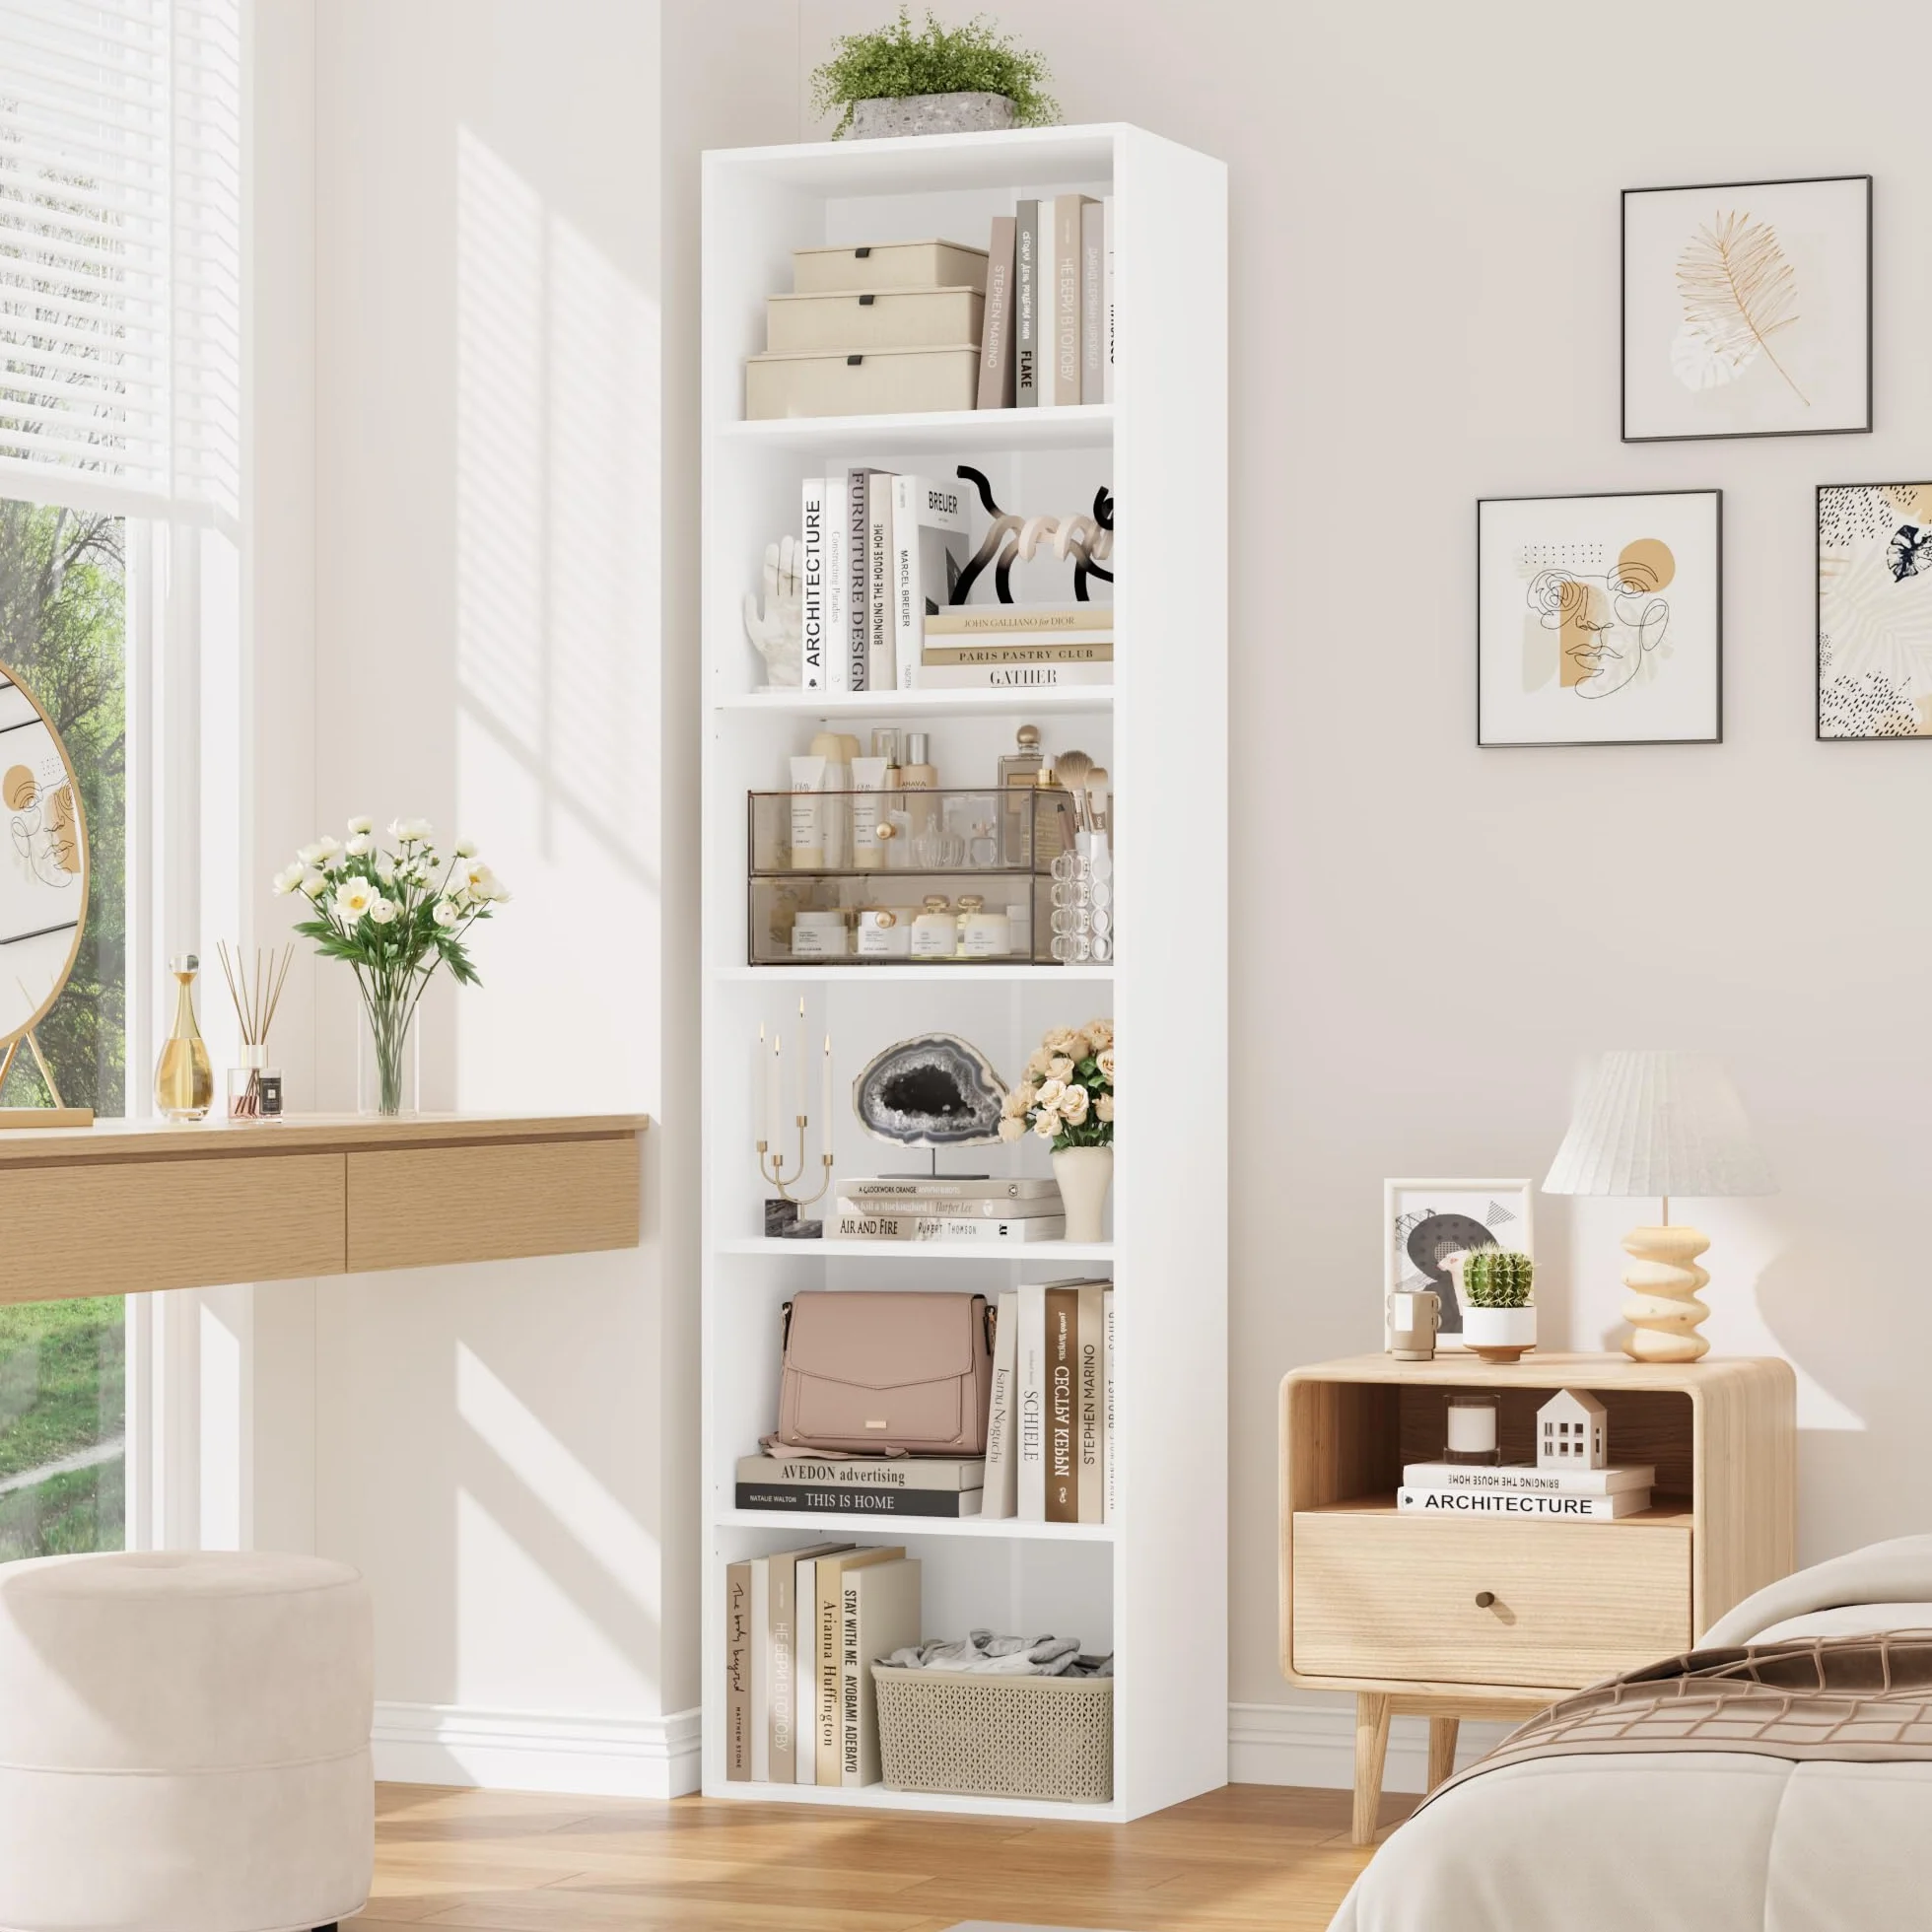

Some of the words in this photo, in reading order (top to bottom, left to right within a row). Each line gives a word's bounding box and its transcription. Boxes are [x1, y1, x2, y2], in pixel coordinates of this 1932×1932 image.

[1060, 257, 1074, 275] НЕ
[991, 265, 1005, 318] STEPHEN
[1060, 278, 1074, 312] БЕРИ
[1060, 316, 1074, 326] В
[988, 321, 1000, 369] MARINO
[1060, 328, 1074, 381] ГОЛОВУ
[1021, 350, 1032, 388] FLAKE
[929, 491, 958, 516] BREUER
[852, 472, 864, 603] FURNITURE
[873, 523, 884, 548] HOME
[873, 552, 883, 580] HOUSE
[900, 550, 909, 587] MARCEL
[806, 500, 820, 666] ARCHITECTURE
[873, 583, 883, 599] THE
[902, 590, 911, 627] BREUER
[964, 618, 989, 628] JOHN
[990, 618, 1038, 628] GALLIANO
[1038, 617, 1051, 628] for
[1051, 616, 1075, 627] DIOR
[873, 602, 883, 646] BRINGING
[852, 611, 864, 691] DESIGN
[959, 652, 998, 661] PARIS
[1002, 651, 1053, 660] PASTRY
[1059, 649, 1094, 658] CLUB
[990, 669, 1058, 685] GATHER
[935, 1201, 958, 1213] Harper
[959, 1202, 973, 1213] Lee
[840, 1218, 856, 1233] AIR
[879, 1218, 898, 1234] FIRE
[1084, 1344, 1095, 1399] MARINO
[994, 1368, 1009, 1406] Isamu
[990, 1409, 1005, 1464] Noguchi
[1024, 1390, 1039, 1461] SCHIELE
[1084, 1404, 1095, 1465] STEPHEN
[781, 1464, 836, 1481] AVEDON
[839, 1466, 906, 1486] advertising
[1448, 1474, 1471, 1485] HOME
[1473, 1475, 1499, 1486] HOUSE
[1501, 1476, 1518, 1487] THE
[1520, 1477, 1559, 1488] BRINGING
[805, 1492, 836, 1507] THIS
[839, 1494, 851, 1508] IS
[855, 1495, 895, 1509] HOME
[1425, 1493, 1593, 1514] ARCHITECTURE
[732, 1582, 744, 1610] The
[845, 1590, 857, 1616] STAY
[775, 1622, 789, 1640] НЕ
[823, 1600, 837, 1659] Arianna
[845, 1619, 858, 1646] WITH
[726, 1649, 745, 1692] beyond
[775, 1643, 789, 1680] БЕРИ
[845, 1650, 858, 1666] ME
[775, 1683, 789, 1692] В
[845, 1675, 858, 1722] AYOBAMI
[819, 1666, 837, 1747] Huffington
[775, 1695, 789, 1753] ГОЛОВУ
[845, 1725, 858, 1773] ADEBAYO
